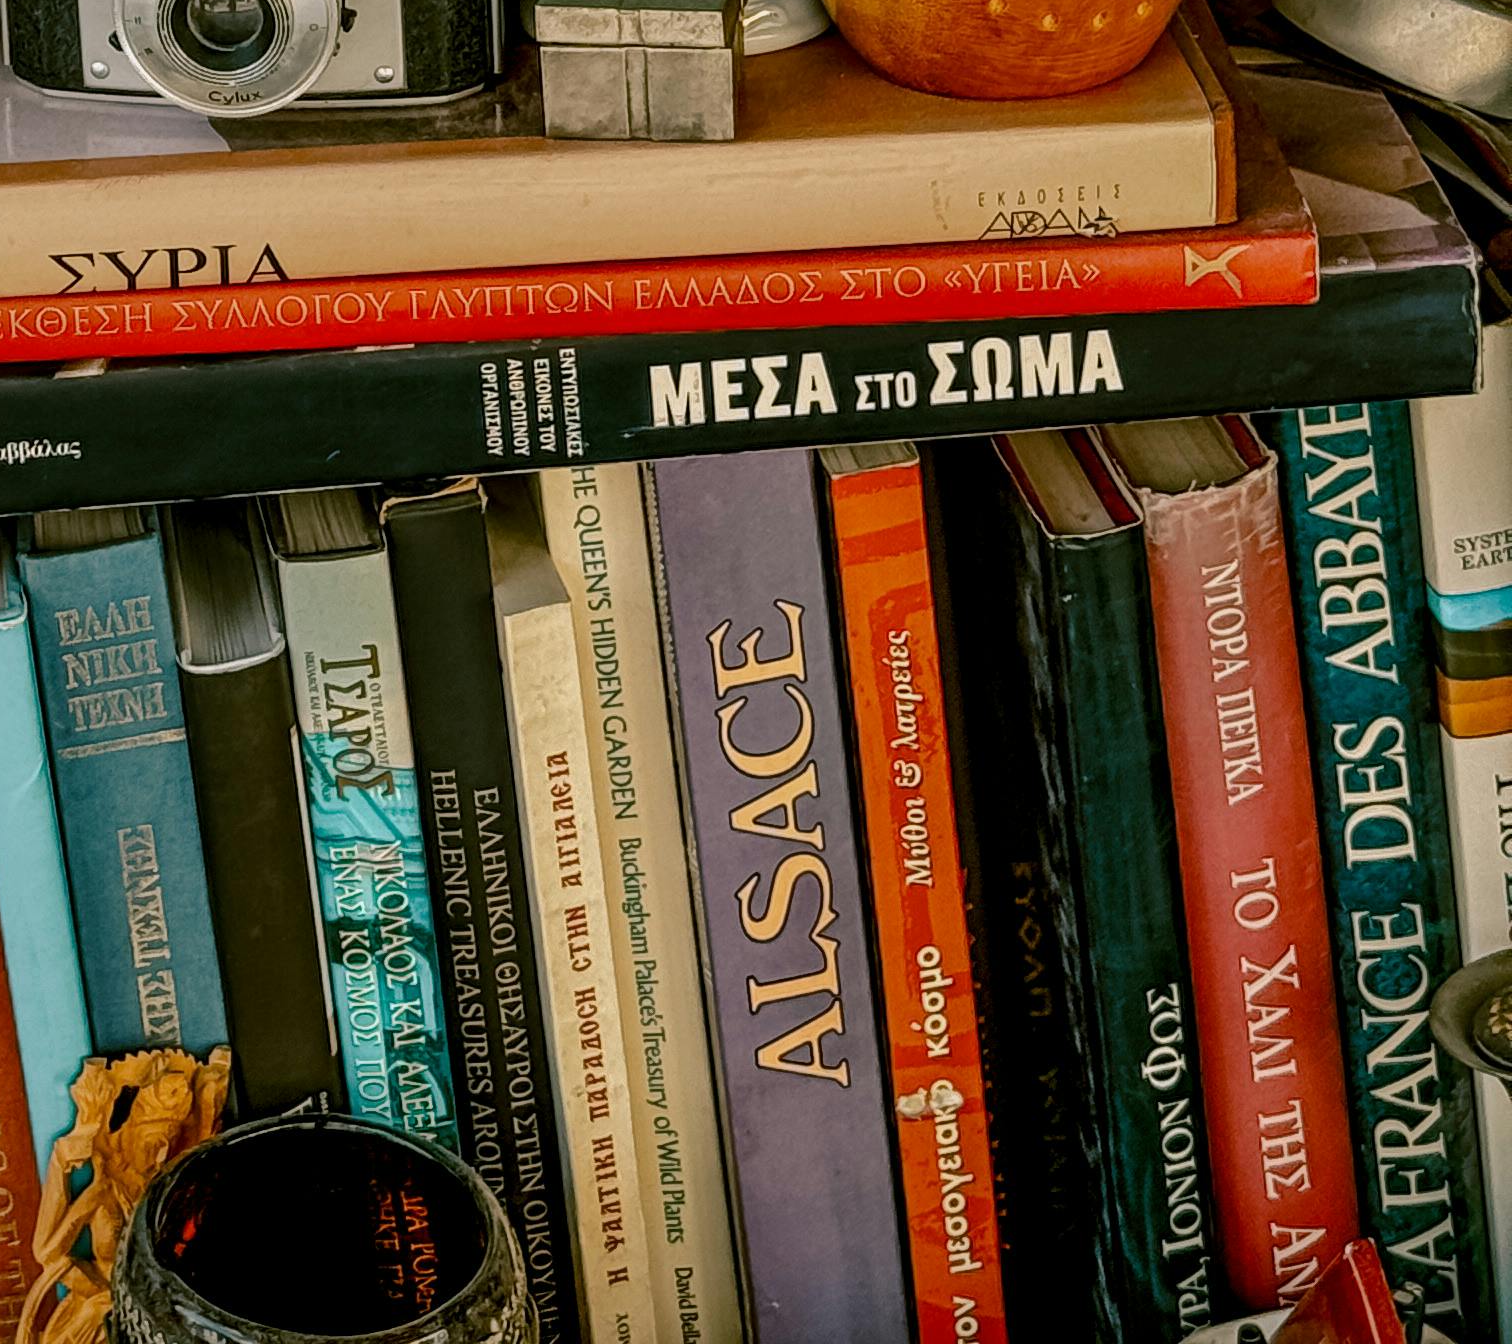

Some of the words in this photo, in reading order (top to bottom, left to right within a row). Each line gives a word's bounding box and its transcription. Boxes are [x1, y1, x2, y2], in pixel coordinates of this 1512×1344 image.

[48, 242, 290, 293] ΣΥΡΙΑ
[172, 291, 392, 333] ΣΥΛΛΟΓΟΥ
[409, 280, 614, 322] ΓΛΥΠΤΩΝ
[633, 271, 824, 311] ΕΛΛΑΔΟΣ
[841, 266, 927, 301] ΣΤΟ
[649, 351, 837, 428] ΜΕΣΑ
[854, 370, 917, 413] ΣΤΟ
[929, 329, 1126, 407] ΣΩΜΑ
[589, 618, 626, 708] HIDDEN
[1199, 562, 1248, 682] ΝΤΟΡΑ
[889, 630, 915, 746] λατρείες
[599, 715, 639, 818] GARDEN
[1216, 687, 1265, 805] ΠΕΓΚΑ
[1334, 715, 1419, 869] DES
[707, 597, 850, 1087] ALSACE
[905, 797, 934, 889] Μύθοι
[615, 837, 657, 955] Buckingham
[1228, 859, 1279, 930] ΤΟ
[915, 944, 954, 1060] κόσμο
[1141, 982, 1187, 1090] ΦΩΣ
[1239, 945, 1301, 1081] ΧΑΛΙ
[635, 1028, 672, 1108] Treasury
[1353, 904, 1450, 1212] FRANCE
[653, 1115, 678, 1135] of
[656, 1139, 685, 1184] Wild
[1258, 1101, 1313, 1199] ΤΗΣ
[660, 1188, 688, 1244] Plants
[1158, 1099, 1205, 1258] ΙΟΝΙΟΝ
